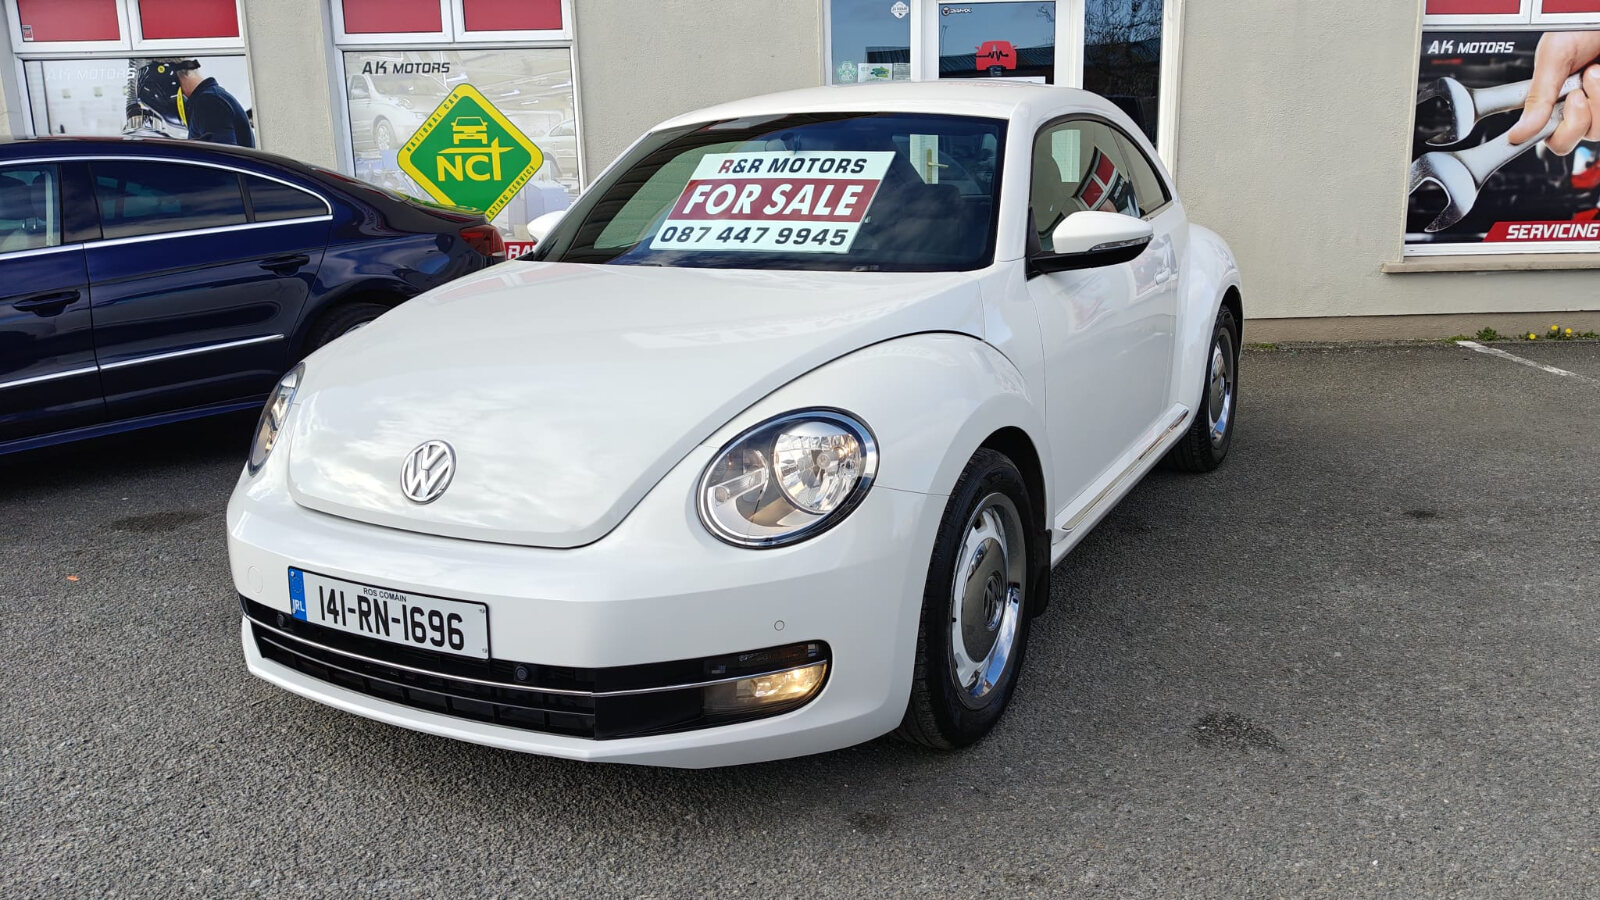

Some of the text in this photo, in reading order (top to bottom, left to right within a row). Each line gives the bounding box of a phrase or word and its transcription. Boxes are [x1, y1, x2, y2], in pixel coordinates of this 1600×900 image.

[1427, 40, 1515, 54] AK MOTORS
[77, 67, 136, 80] MOTORS
[362, 61, 450, 75] AK MOTORS
[405, 93, 459, 153] NATIONAL CAR
[717, 157, 867, 174] R&R MOTORS
[486, 165, 535, 219] ESTING SERVICE
[682, 183, 864, 216] FOR SALE
[660, 226, 849, 246] 087 447 9945
[1505, 223, 1600, 239] SERVICING
[363, 587, 378, 597] ROS
[291, 598, 305, 613] IRL
[318, 585, 465, 651] 141-RN-1696
